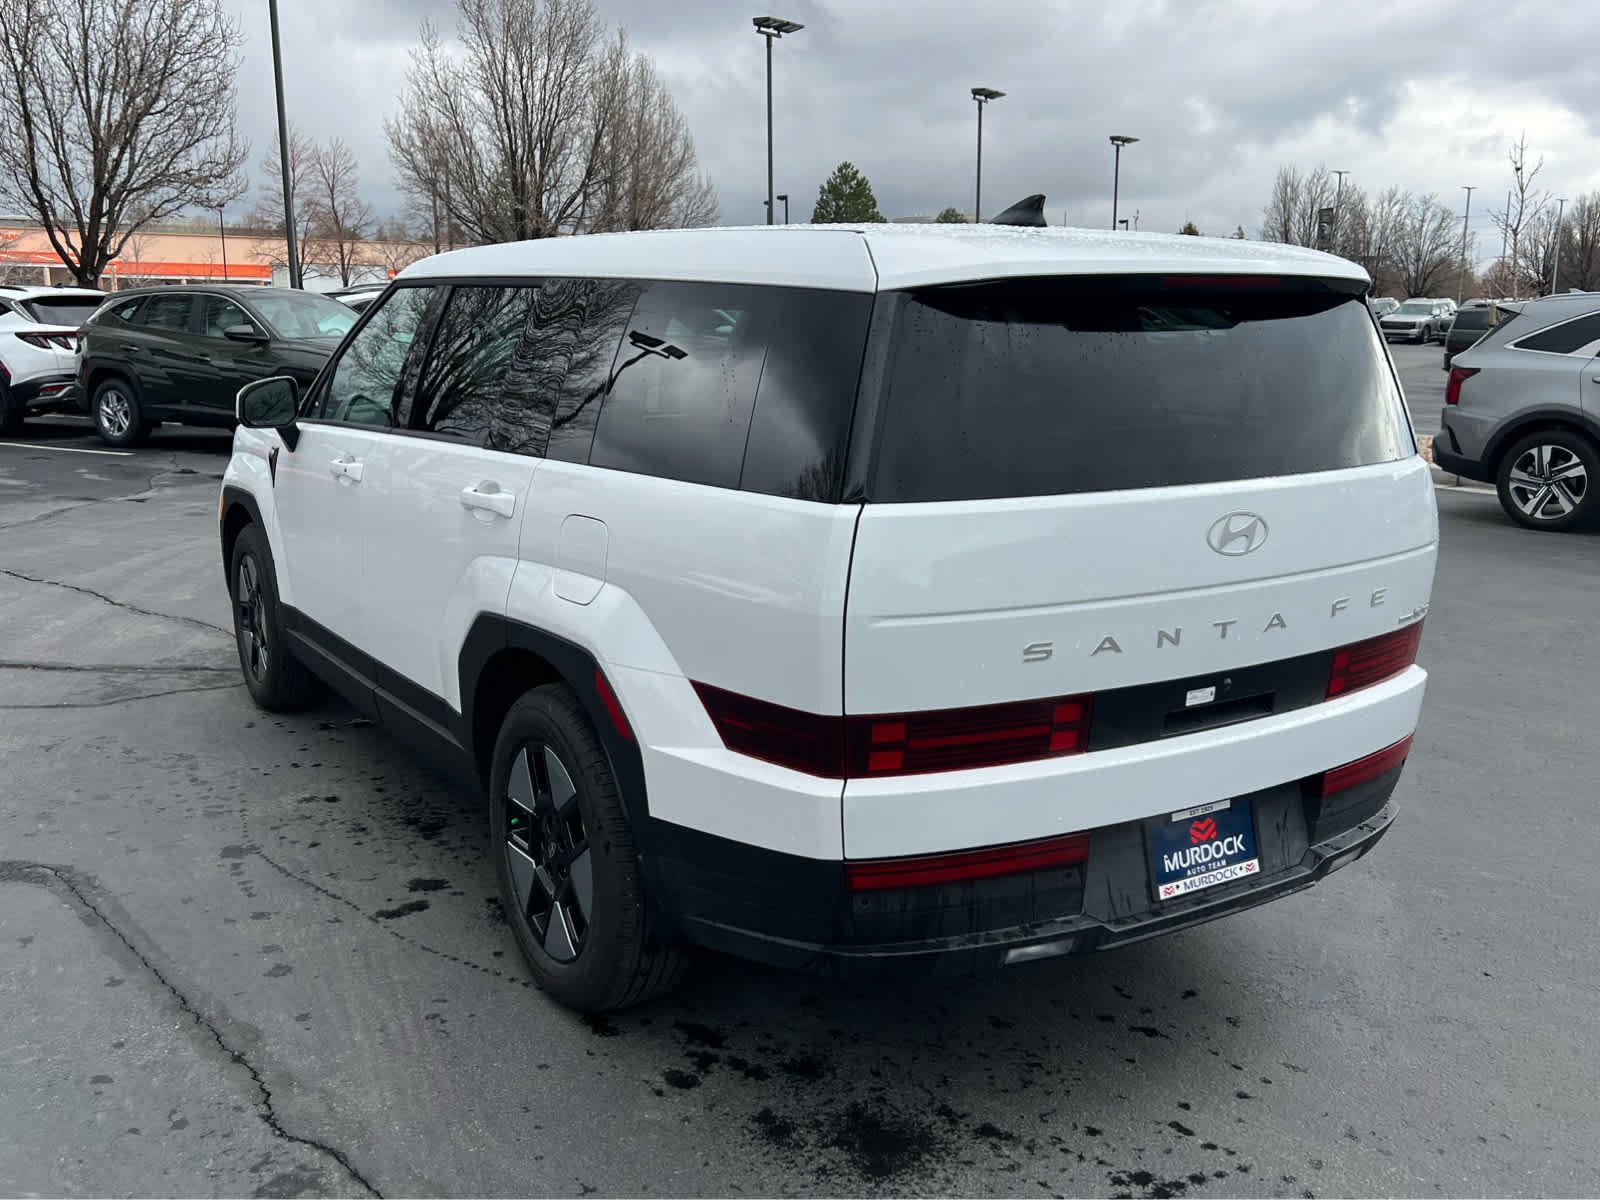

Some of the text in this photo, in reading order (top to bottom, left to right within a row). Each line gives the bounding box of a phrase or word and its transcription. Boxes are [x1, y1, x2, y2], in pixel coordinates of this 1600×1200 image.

[1022, 611, 1288, 664] SANTA
[1330, 587, 1388, 619] FE
[1164, 834, 1246, 872] MURDOCK
[1187, 860, 1226, 876] AUTO TEAM
[1183, 867, 1238, 890] MURDOCK
